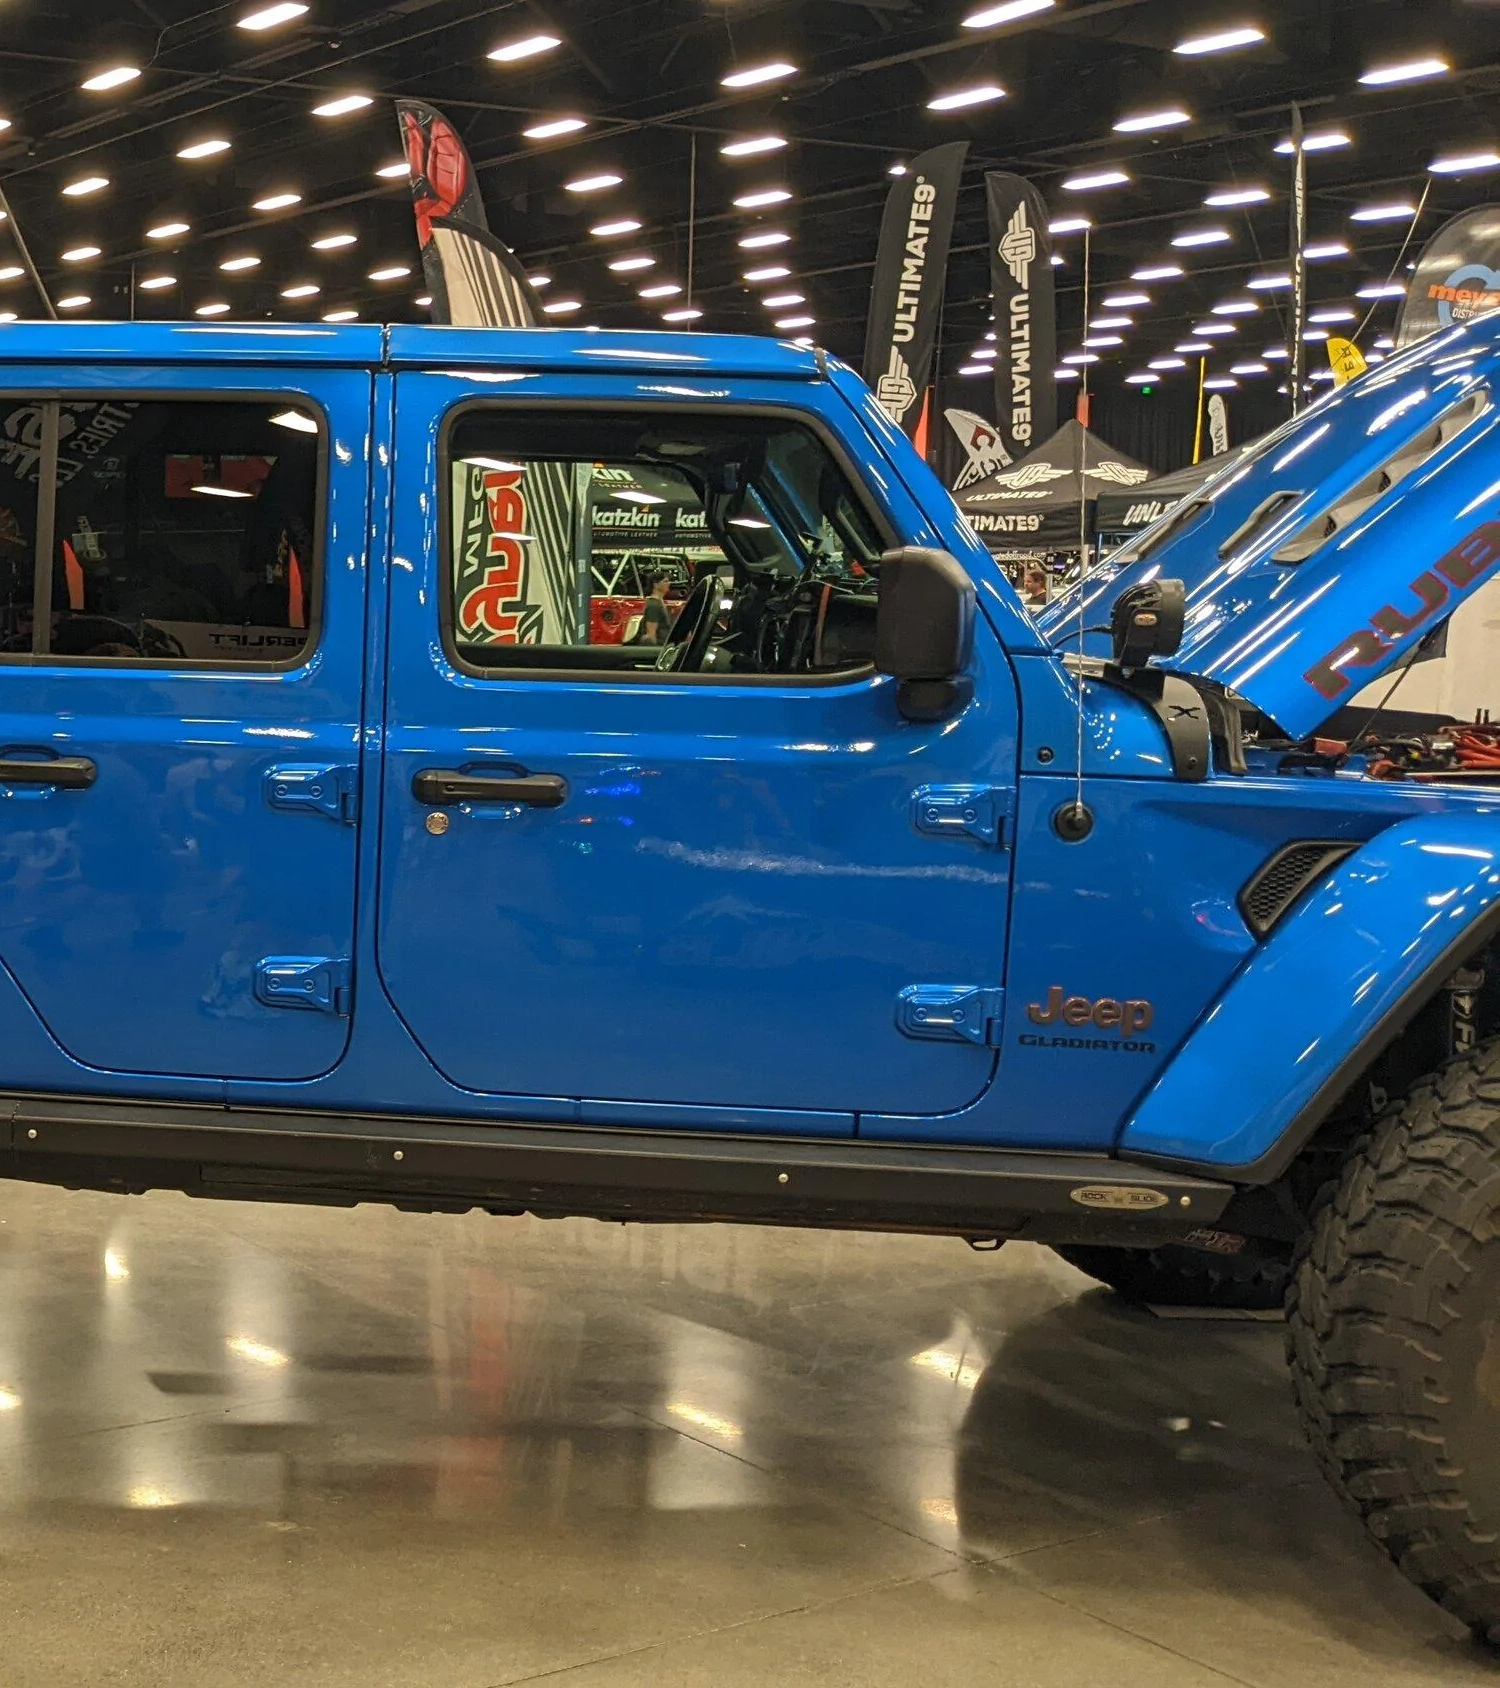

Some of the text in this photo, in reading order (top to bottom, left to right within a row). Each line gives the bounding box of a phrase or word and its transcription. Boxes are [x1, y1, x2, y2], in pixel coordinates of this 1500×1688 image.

[592, 504, 708, 528] katzkin kat
[966, 515, 1039, 531] TIMATE9
[1027, 985, 1154, 1037] Jeep
[1018, 1034, 1156, 1053] GLADIATOR
